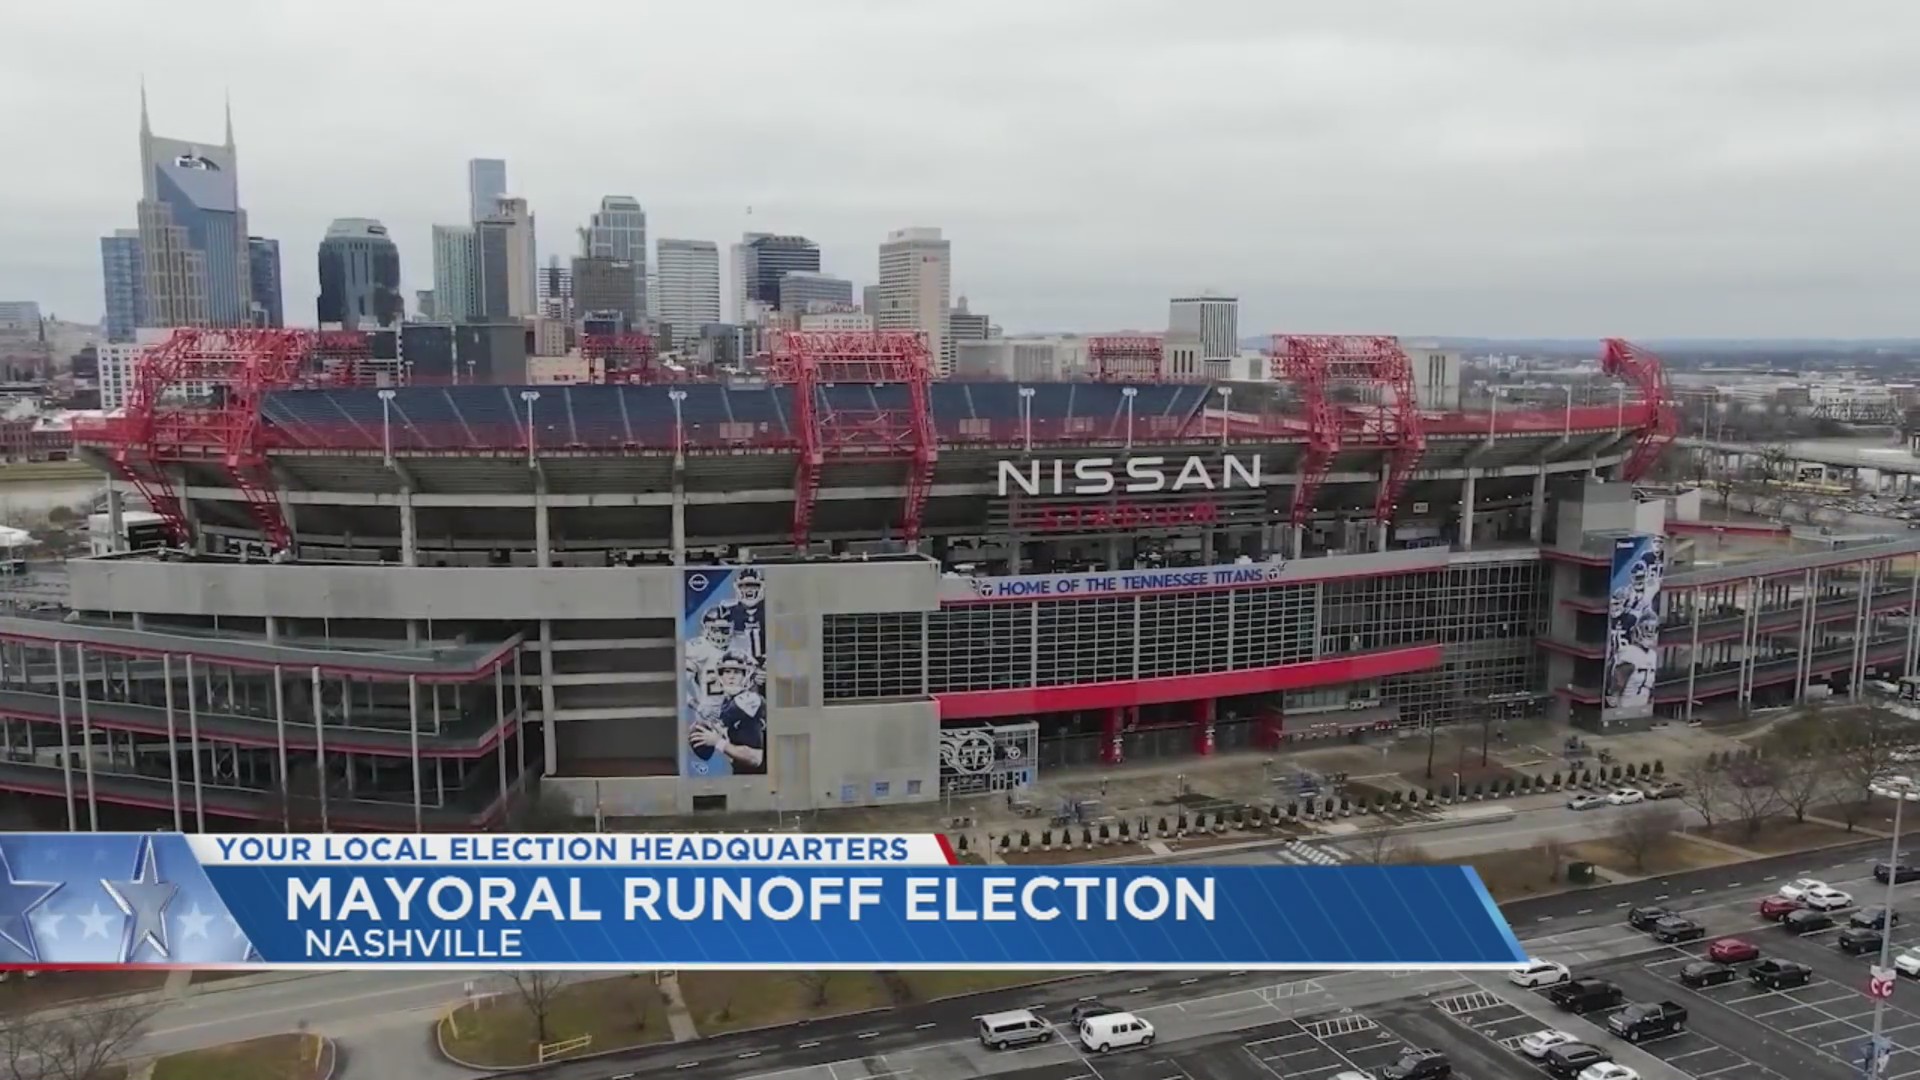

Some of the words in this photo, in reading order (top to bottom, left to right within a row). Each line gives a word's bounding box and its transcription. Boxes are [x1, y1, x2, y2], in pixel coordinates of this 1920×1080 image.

[998, 454, 1262, 496] NISSAN
[1000, 580, 1050, 597] HOME
[1056, 578, 1080, 594] OF
[1086, 576, 1117, 592] THE
[1122, 571, 1209, 590] TENNESSEE
[1213, 568, 1264, 586] TITANS
